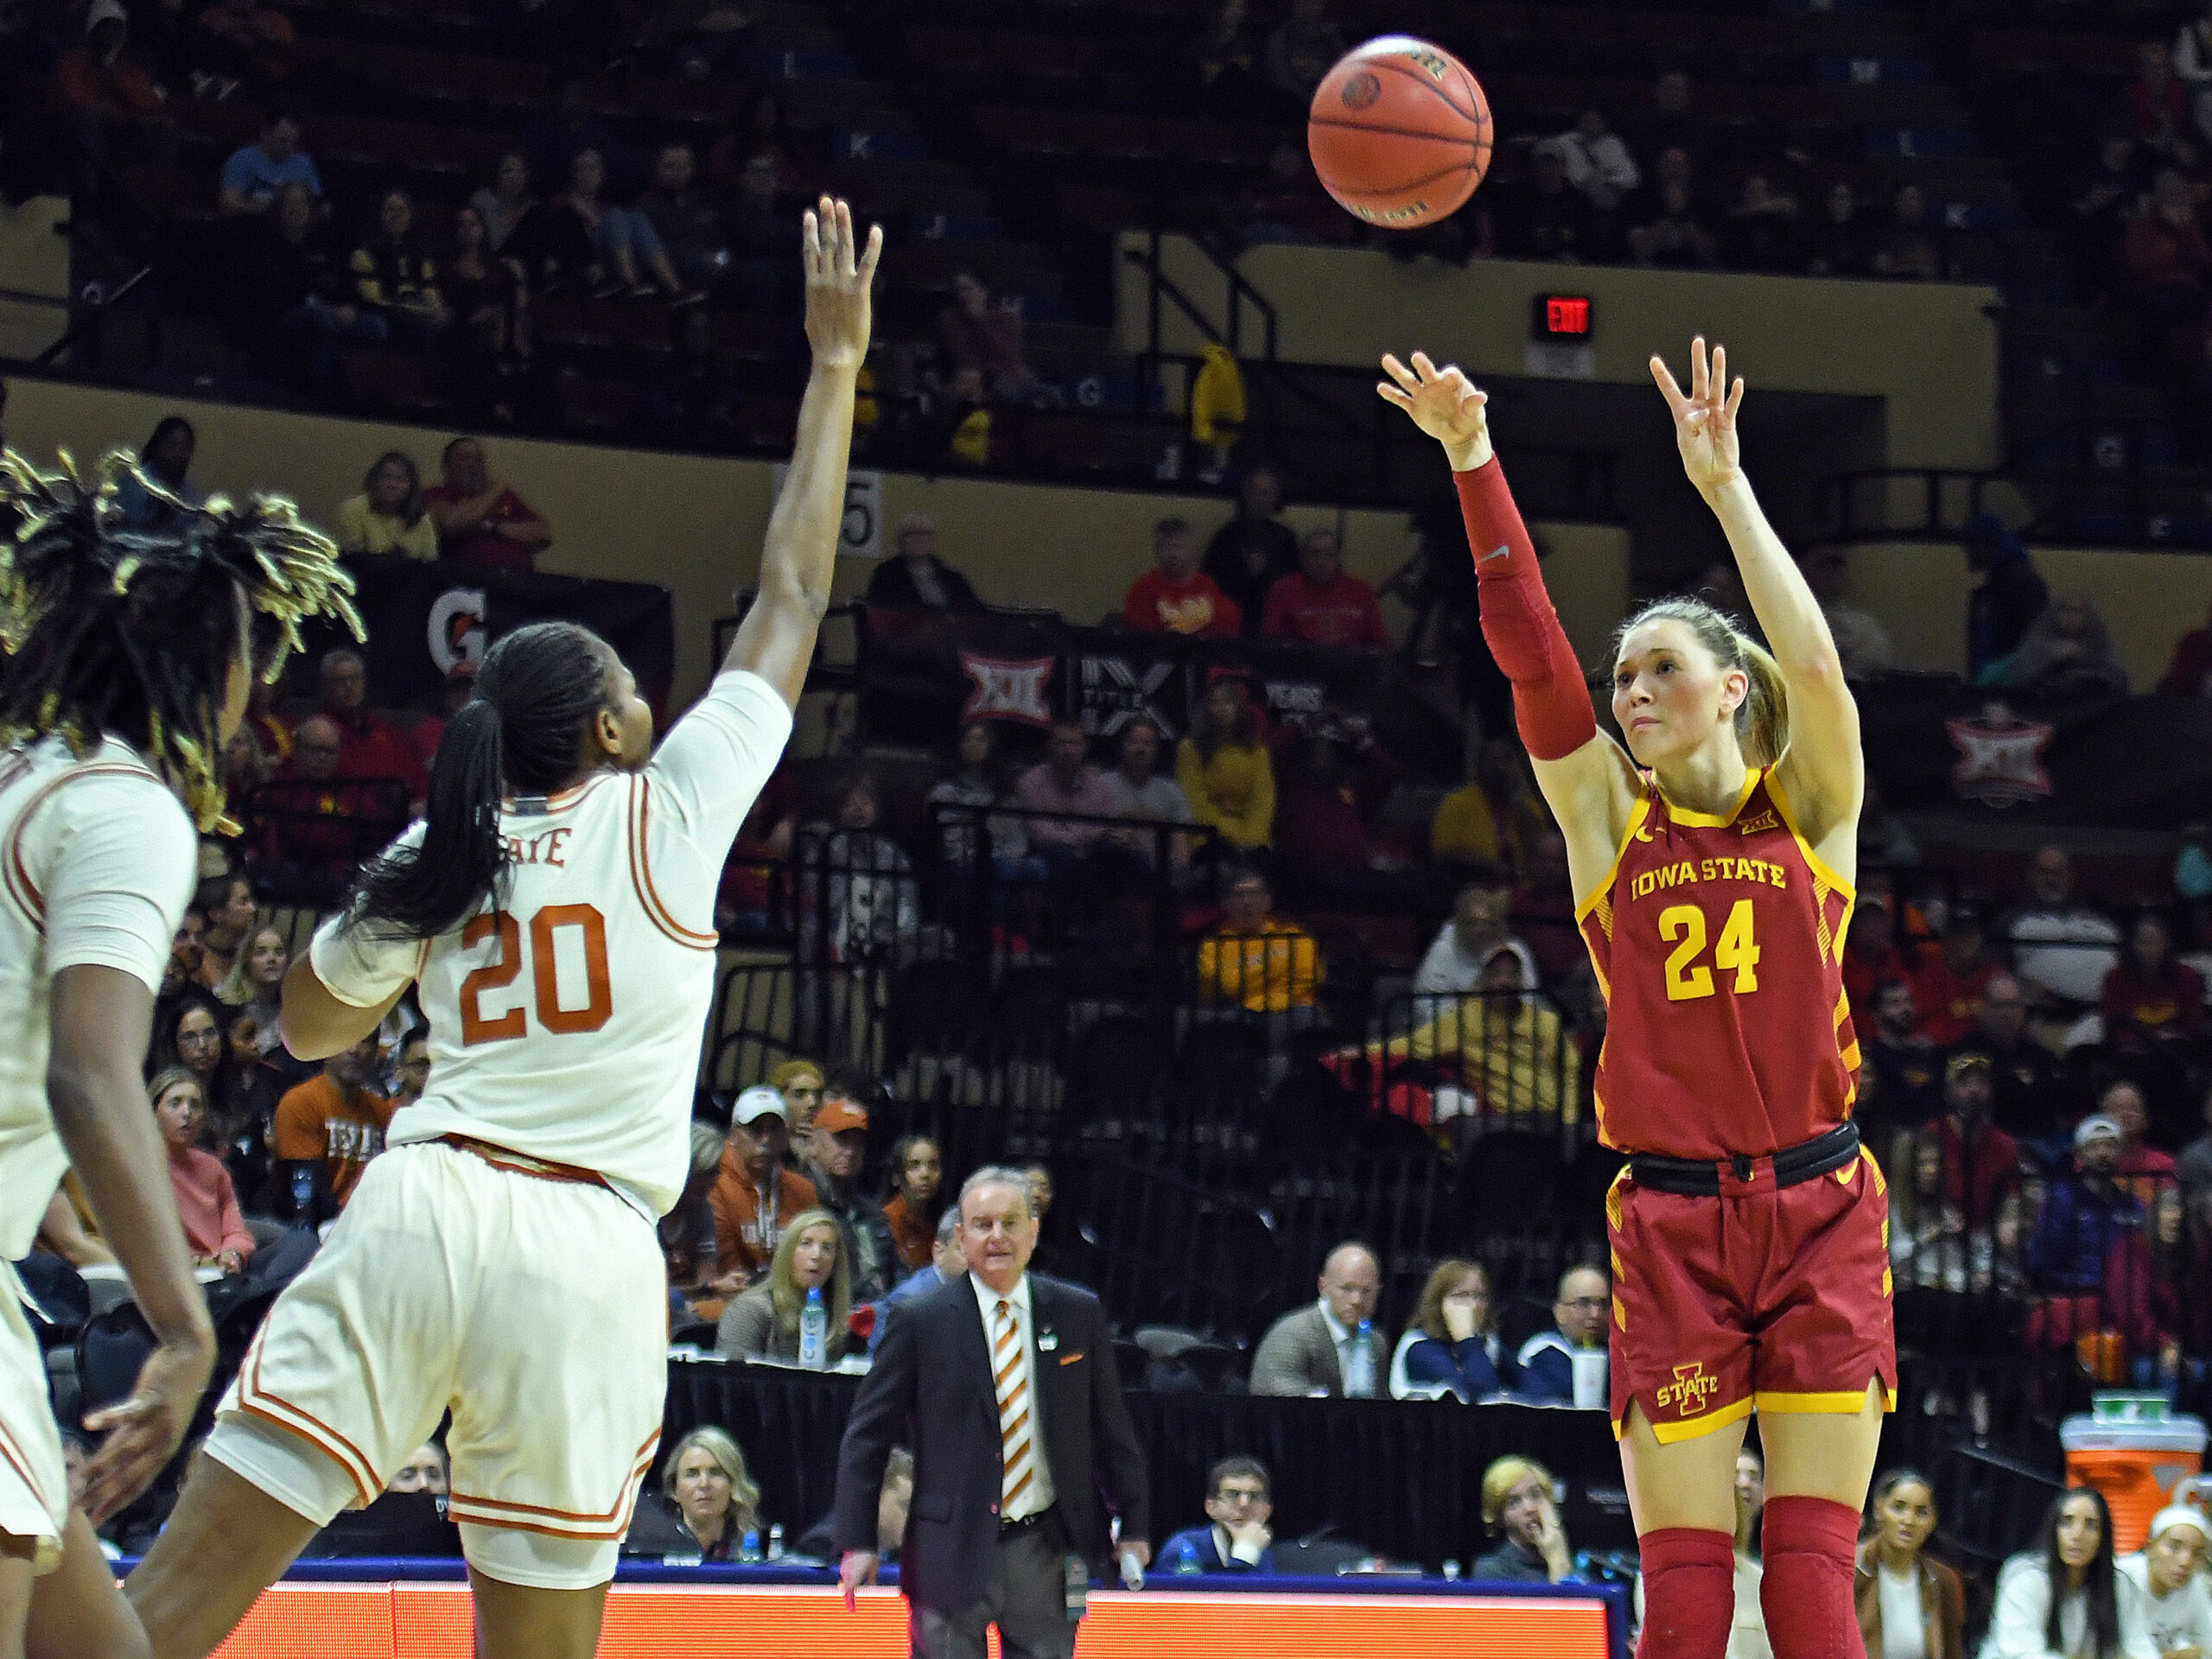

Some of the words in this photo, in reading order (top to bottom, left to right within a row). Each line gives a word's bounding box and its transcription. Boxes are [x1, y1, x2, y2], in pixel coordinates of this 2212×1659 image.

[427, 589, 486, 681] G
[503, 827, 572, 868] AYE
[1631, 861, 1698, 902] IOWA
[1700, 857, 1787, 889] STATE
[460, 903, 613, 1047] 20
[1658, 899, 1760, 1001] 24
[1656, 1376, 1718, 1408] STATE
